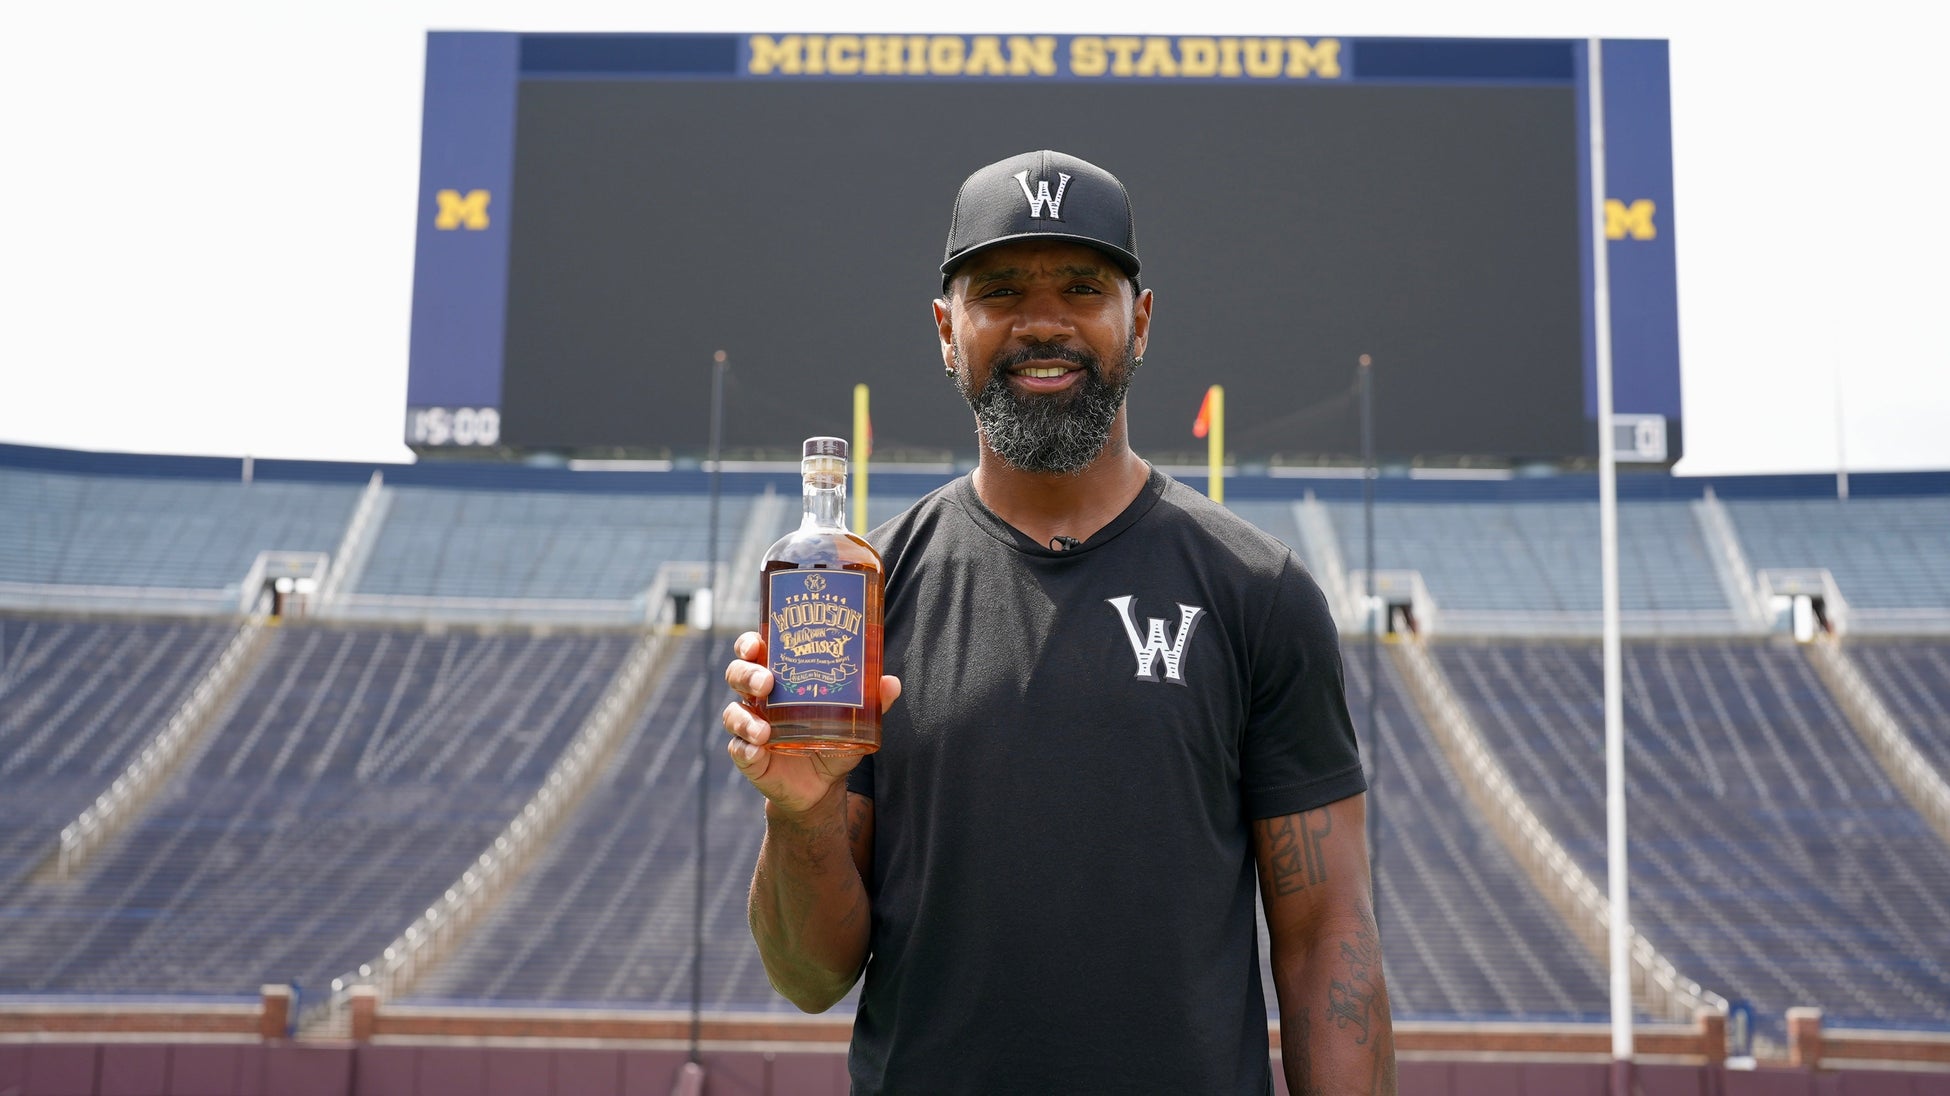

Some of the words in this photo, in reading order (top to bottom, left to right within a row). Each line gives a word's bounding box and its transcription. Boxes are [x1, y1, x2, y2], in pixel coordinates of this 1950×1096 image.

[749, 36, 1056, 76] MICHIGAN
[1070, 37, 1341, 78] STADIUM
[435, 190, 490, 230] M
[1012, 169, 1074, 222] W
[1604, 200, 1656, 240] M
[415, 407, 500, 446] 15:00
[771, 602, 863, 635] WOODSON
[785, 593, 820, 604] TEAM
[1104, 595, 1207, 687] W
